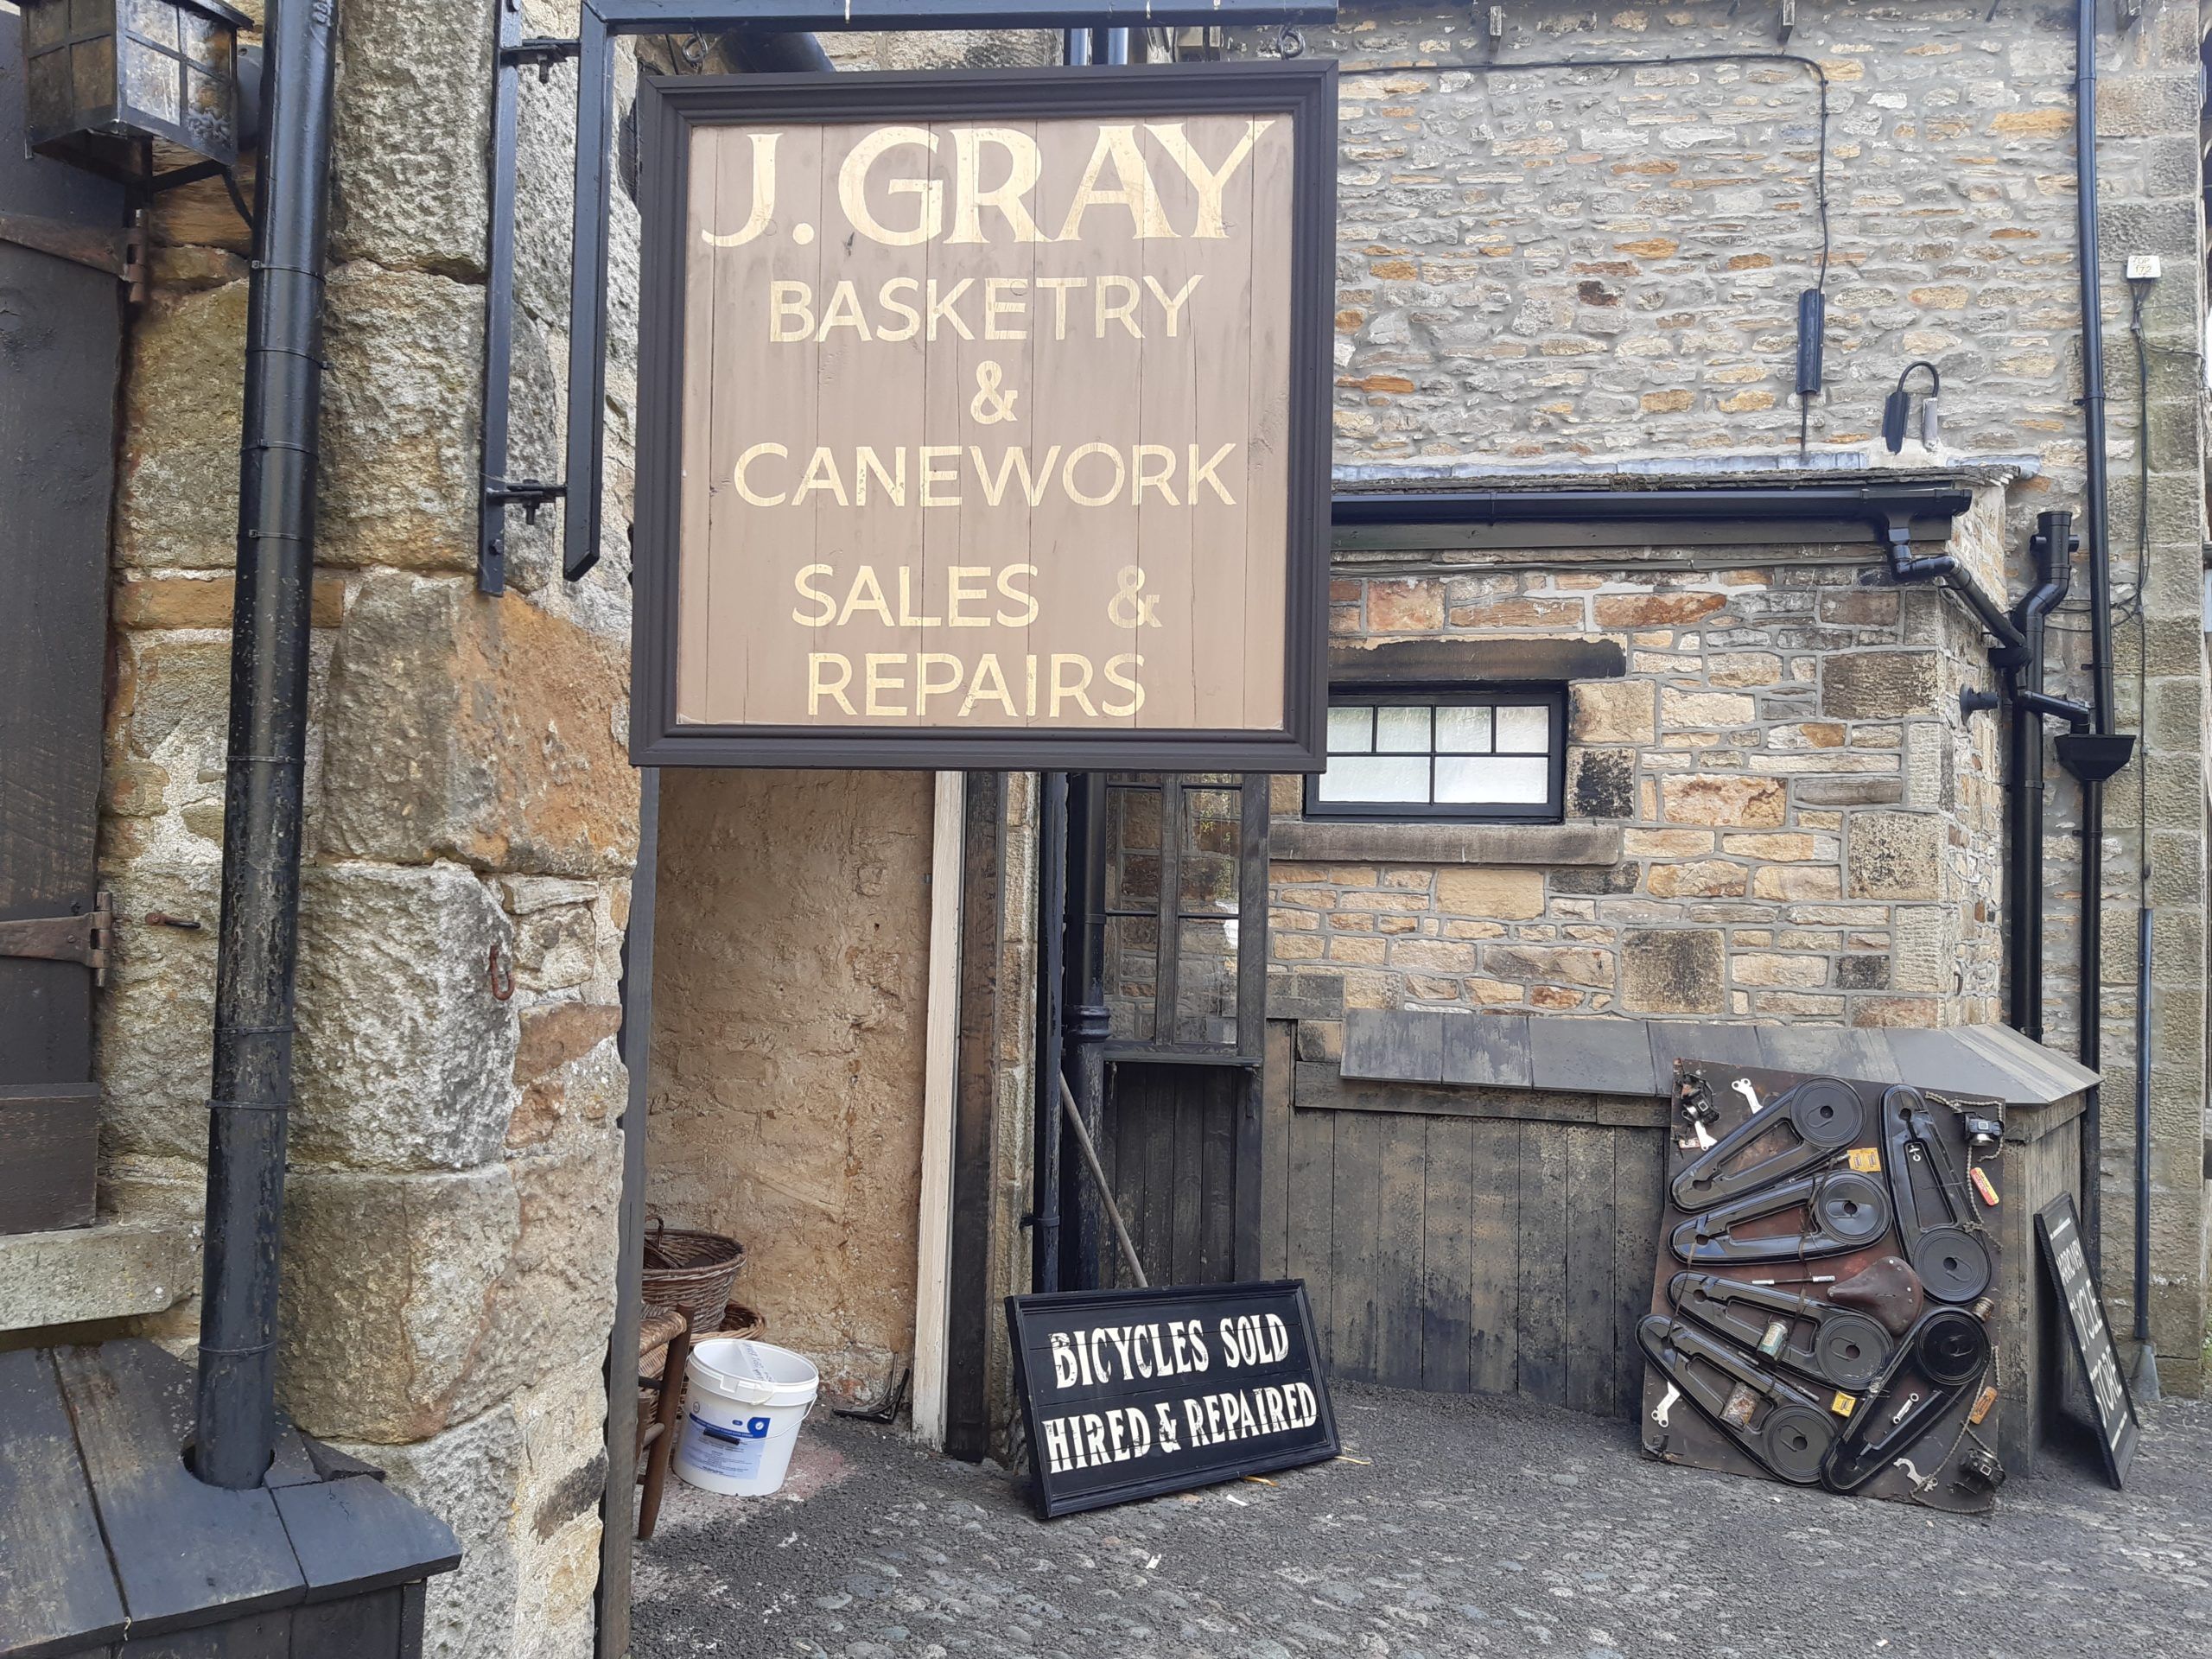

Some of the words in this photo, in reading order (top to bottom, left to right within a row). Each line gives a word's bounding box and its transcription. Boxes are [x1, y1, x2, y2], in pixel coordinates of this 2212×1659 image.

[702, 132, 814, 246] J.
[837, 120, 1276, 246] GRAY
[768, 274, 1205, 344] BASKETRY
[969, 359, 1018, 425] &
[734, 442, 1237, 508] CANEWORK
[792, 563, 1039, 628] SALES
[1108, 564, 1163, 629] &
[808, 652, 1145, 718] REPAIRS
[2069, 1279, 2103, 1351] CYCLE
[1048, 1319, 1209, 1389] BICYCLES
[1219, 1313, 1289, 1368] SOLD
[1042, 1407, 1151, 1474] HIRED
[1154, 1402, 1182, 1452] &
[1185, 1382, 1317, 1447] REPAIRED
